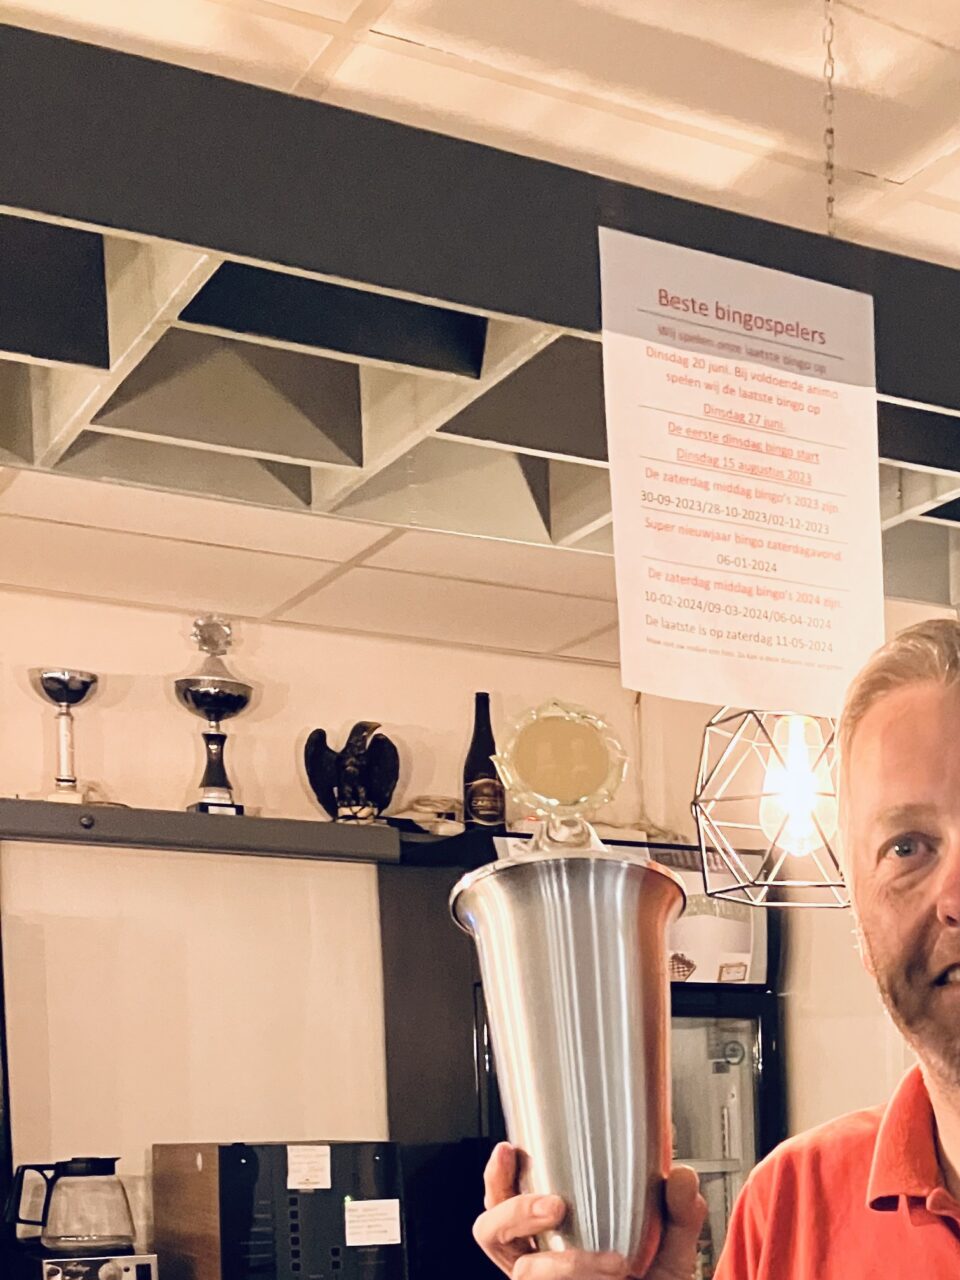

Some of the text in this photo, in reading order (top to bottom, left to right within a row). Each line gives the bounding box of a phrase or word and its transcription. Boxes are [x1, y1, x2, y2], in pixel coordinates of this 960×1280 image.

[658, 288, 826, 345] Beste bingospelers
[646, 346, 689, 369] Dinsdag
[692, 358, 705, 370] 20
[735, 366, 748, 382] Bij
[750, 371, 803, 393] voldoende
[806, 382, 838, 399] animo
[666, 371, 821, 416] spelen wij de laatste bingo op
[704, 403, 745, 424] Dinsdag
[748, 413, 761, 426] 27
[668, 422, 820, 464] De eerste dinsdag bingo start
[677, 448, 812, 485] Dinsdag 15 augustus 2023
[644, 466, 659, 479] De
[662, 470, 710, 491] zaterdag
[712, 479, 751, 499] middag
[794, 495, 819, 510] 2023
[641, 490, 830, 535] 30-09-2023/28-10-2023/02-12-2023
[644, 517, 675, 535] Super
[678, 523, 732, 544] nieuwjaar
[734, 531, 764, 550] bingo
[716, 553, 778, 573] 06-01-2024
[648, 566, 661, 579] De
[664, 570, 711, 591] zaterdag
[714, 579, 753, 598] middag
[795, 592, 820, 607] 2024
[645, 590, 831, 630] 10-02-2024/09-03-2024/06-04-2024
[645, 614, 833, 653] De laatste is op zaterdag 11-05-2024
